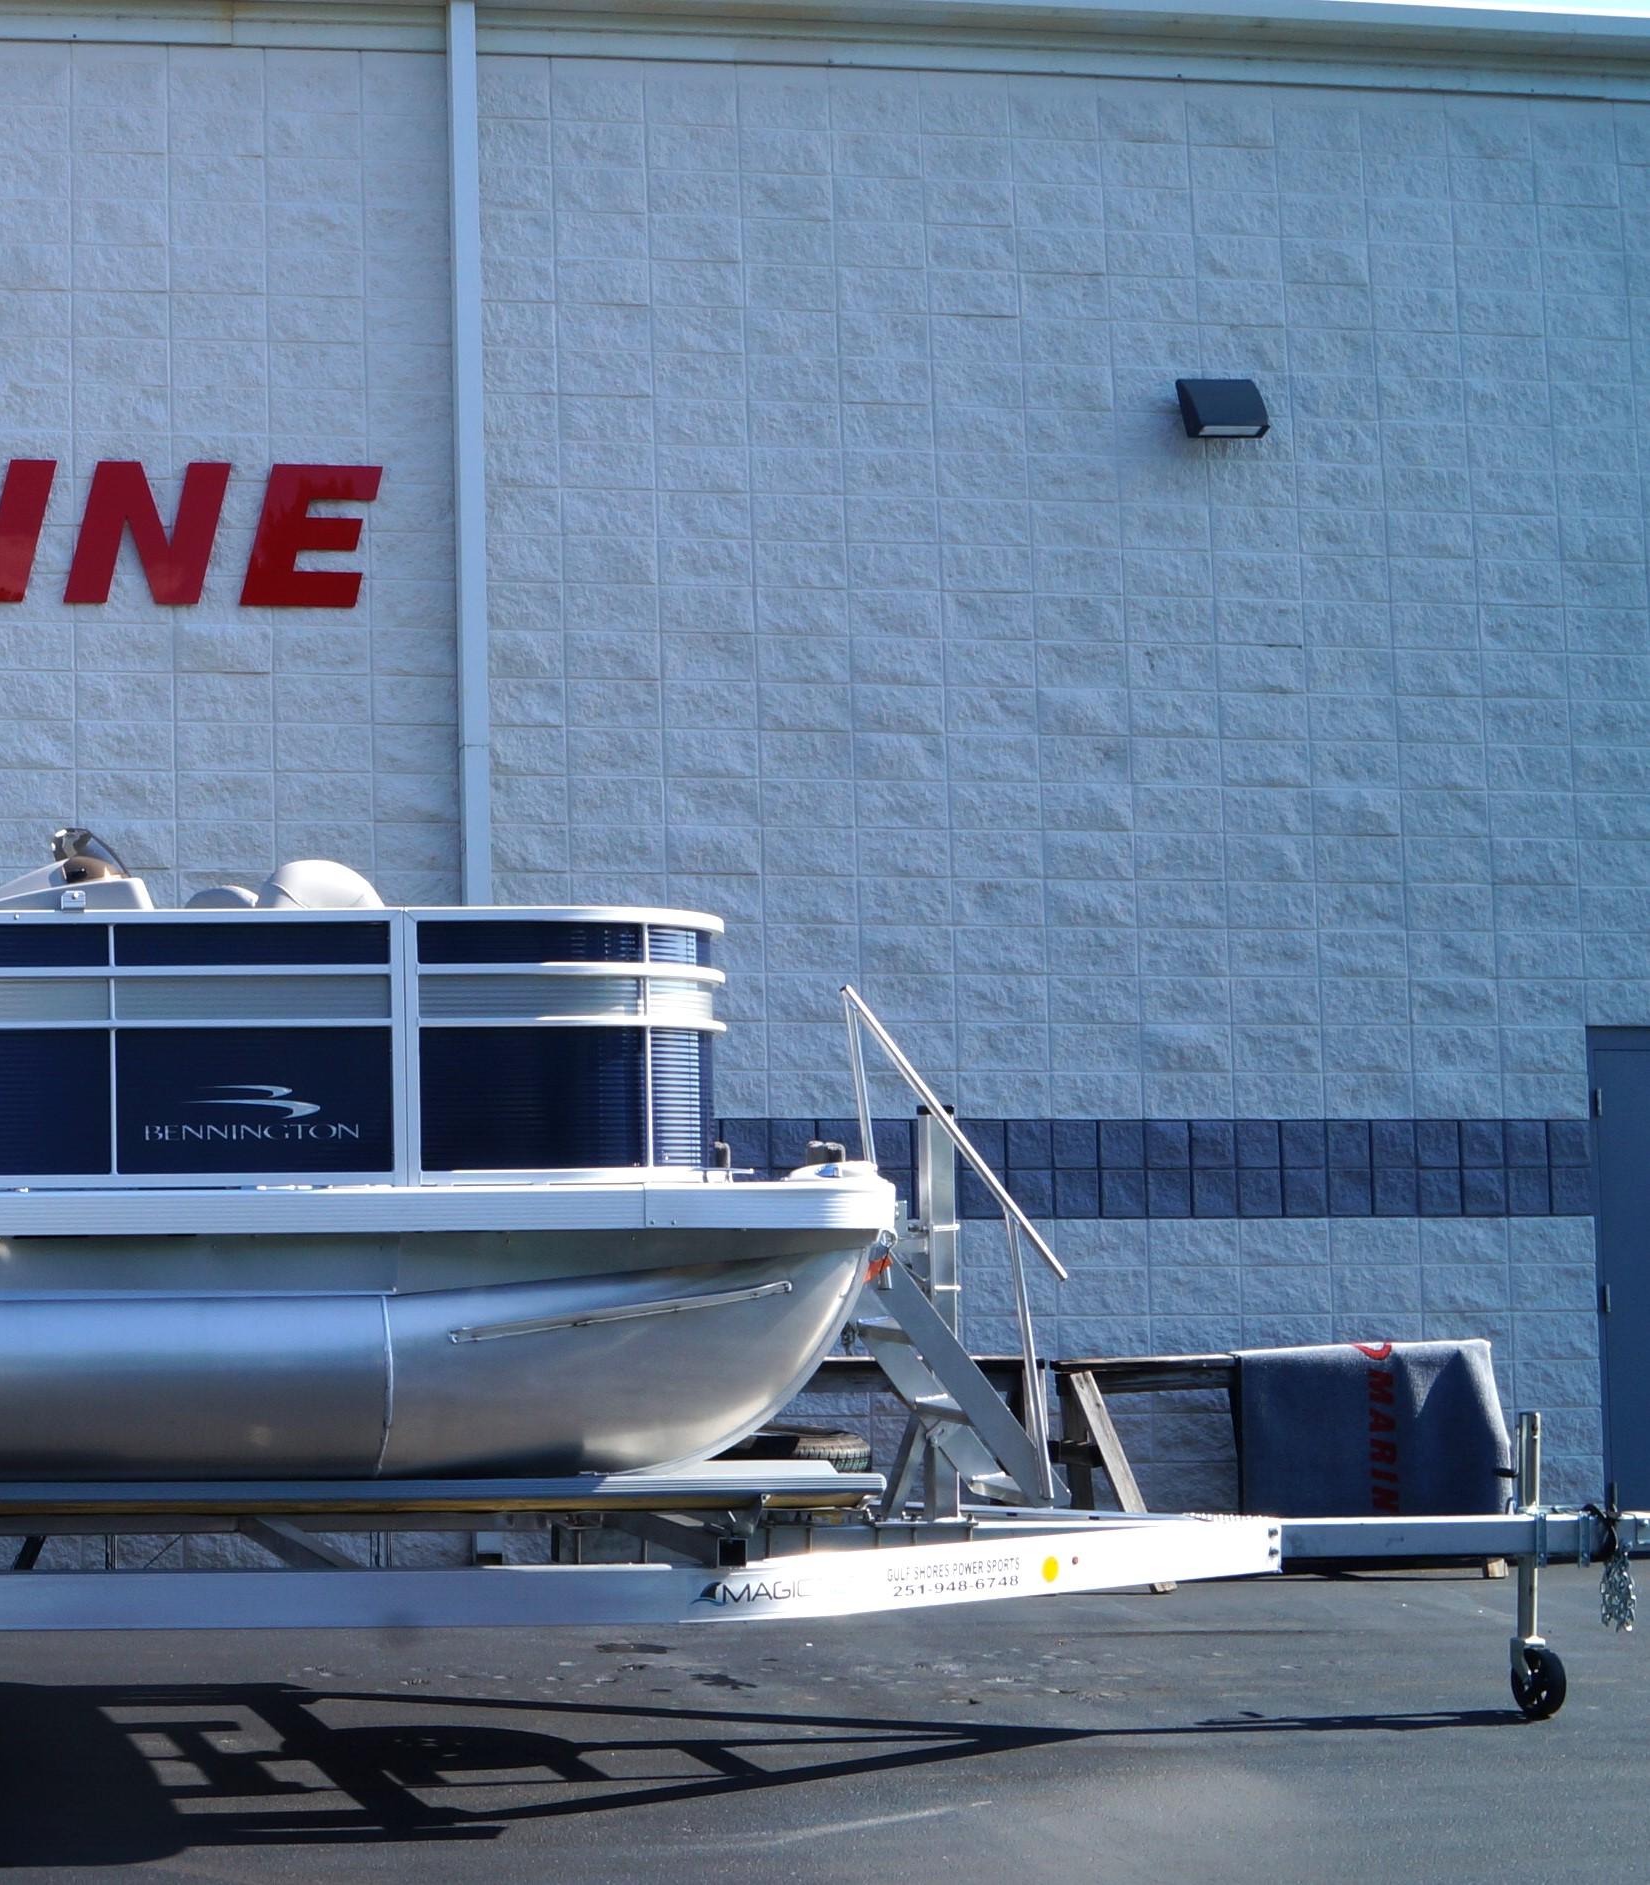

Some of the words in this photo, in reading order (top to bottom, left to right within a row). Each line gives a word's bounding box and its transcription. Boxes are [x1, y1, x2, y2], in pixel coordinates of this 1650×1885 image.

[145, 1122, 360, 1141] BENNINGTON
[887, 1566, 911, 1582] GULF
[913, 1563, 950, 1580] SHORES
[952, 1560, 984, 1576] POWER
[986, 1557, 1020, 1573] SPORTS
[893, 1575, 1019, 1597] 251-948-6748
